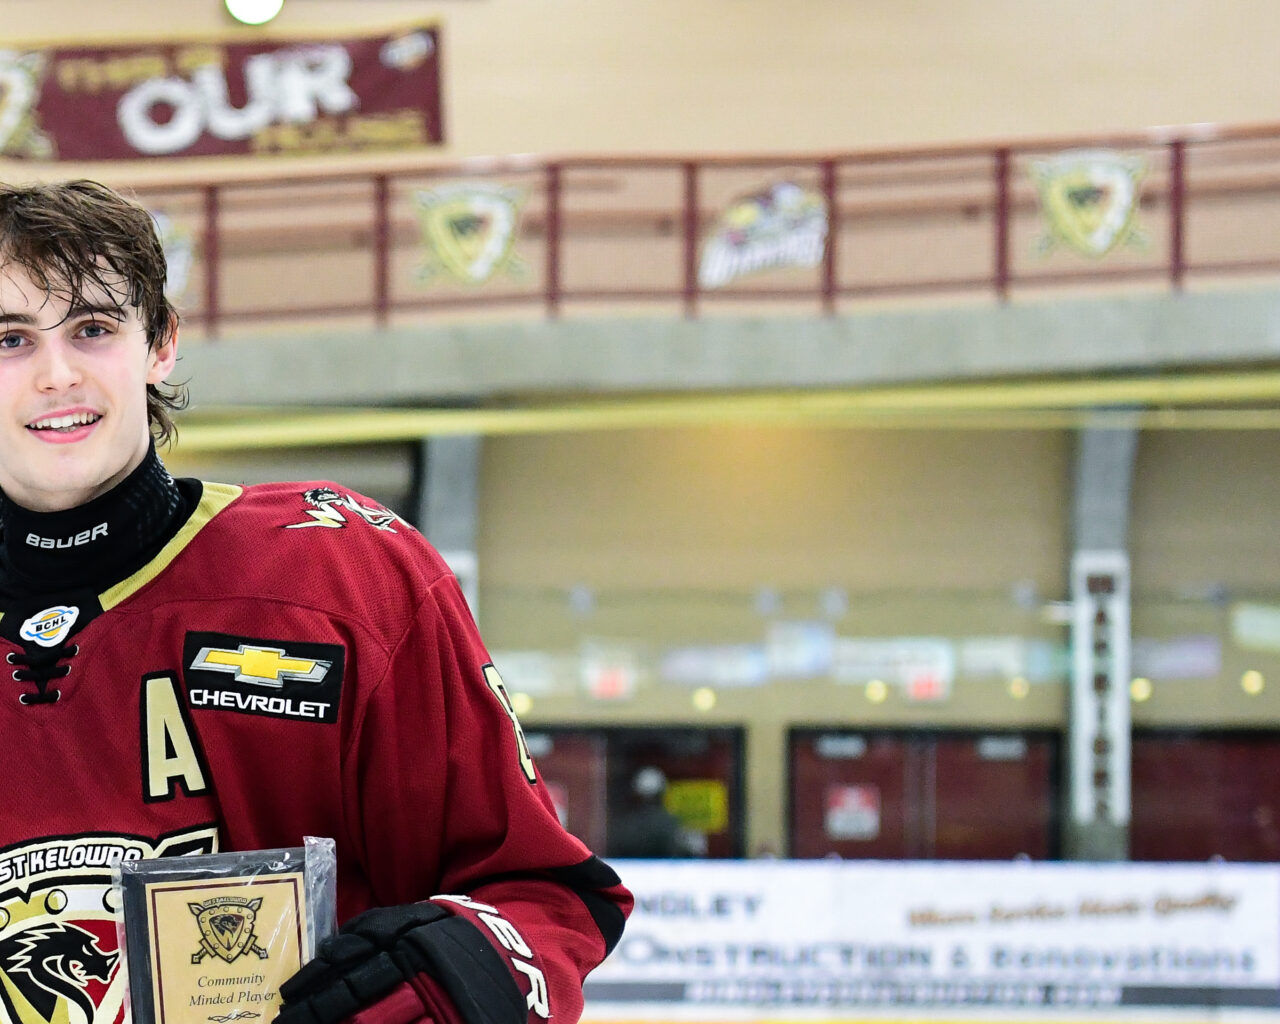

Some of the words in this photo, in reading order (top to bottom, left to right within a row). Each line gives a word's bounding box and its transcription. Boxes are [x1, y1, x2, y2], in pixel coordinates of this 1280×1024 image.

[118, 44, 360, 155] OUR
[24, 522, 109, 549] BAUER
[34, 615, 67, 633] BCHL
[189, 688, 331, 719] CHEVROLET
[142, 672, 209, 800] A
[197, 973, 266, 989] Community
[189, 992, 235, 1007] Minded
[237, 989, 277, 1005] Player
